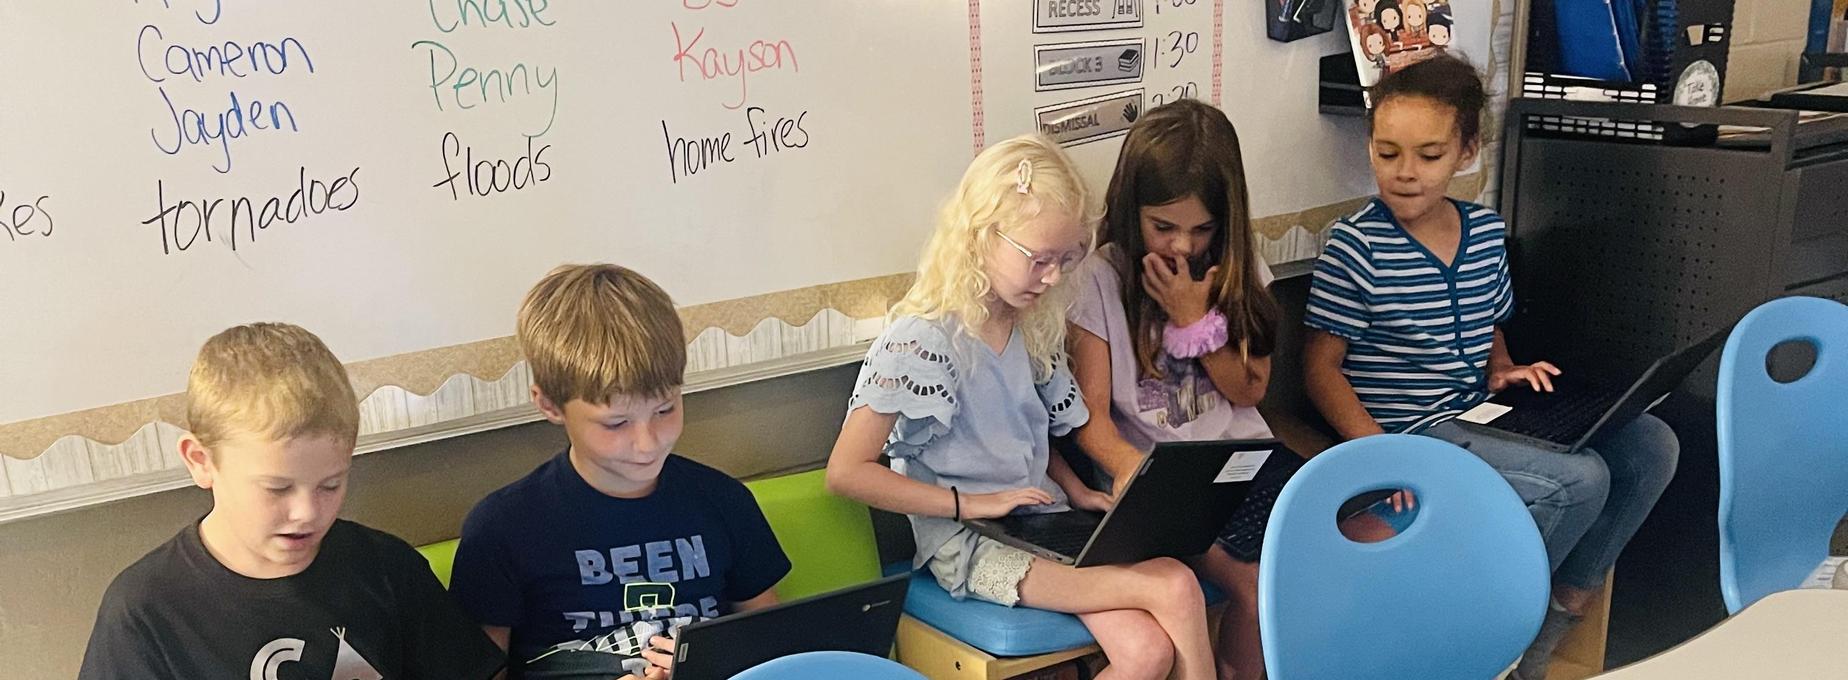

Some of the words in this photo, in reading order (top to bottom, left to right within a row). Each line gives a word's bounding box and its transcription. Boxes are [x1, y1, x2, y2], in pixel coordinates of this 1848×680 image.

[1048, 0, 1101, 18] RECESS
[138, 25, 314, 82] Cameron
[671, 21, 798, 110] Kayson
[1094, 56, 1103, 73] 3
[1153, 30, 1199, 69] 1:30
[411, 41, 558, 137] Penny
[151, 87, 298, 174] Jayden
[661, 119, 736, 184] home
[743, 107, 809, 158] fires
[1042, 113, 1100, 135] DISMISSAL
[433, 132, 551, 200] floods
[141, 166, 360, 255] tornadoes
[574, 534, 711, 585] BEEN
